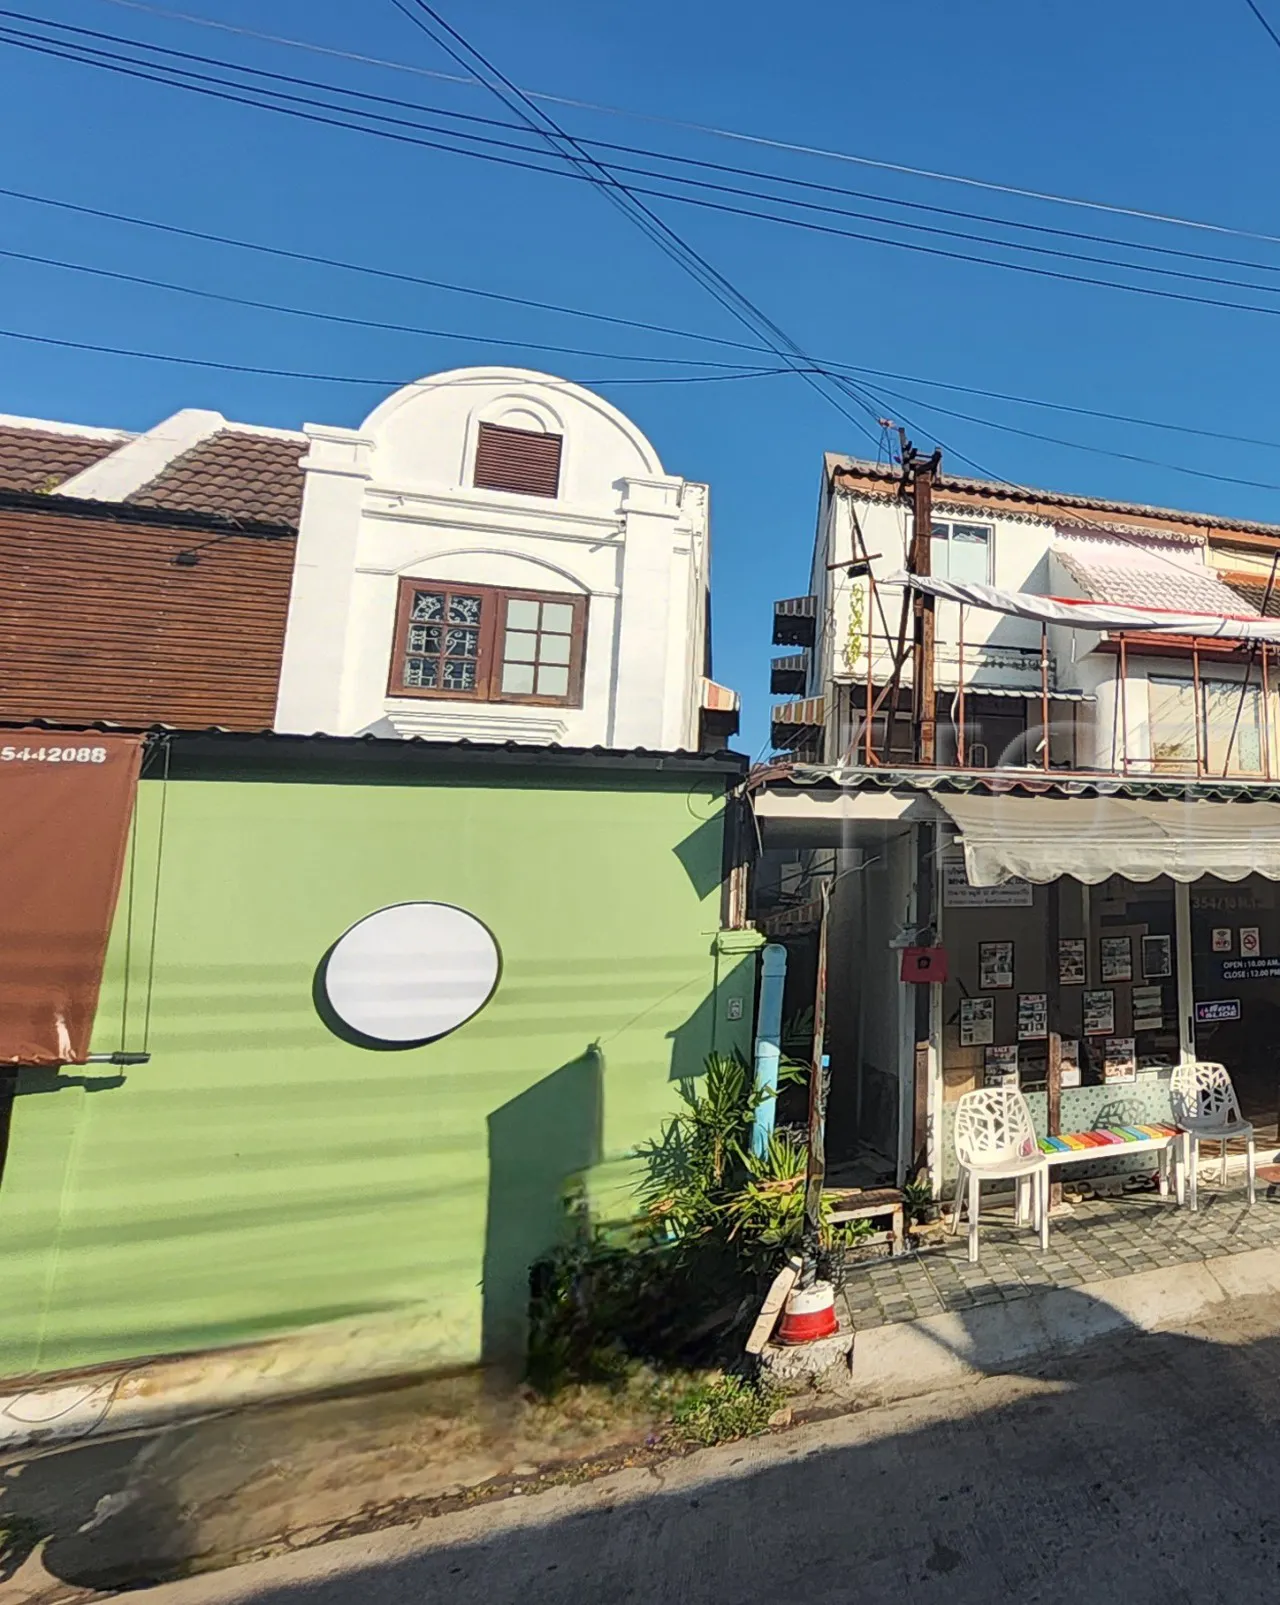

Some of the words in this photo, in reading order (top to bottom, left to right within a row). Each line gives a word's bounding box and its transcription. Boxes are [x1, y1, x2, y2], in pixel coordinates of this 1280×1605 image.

[0, 747, 107, 763] 5442088
[1223, 961, 1243, 969] OPEN
[1223, 971, 1246, 979] CLOSE
